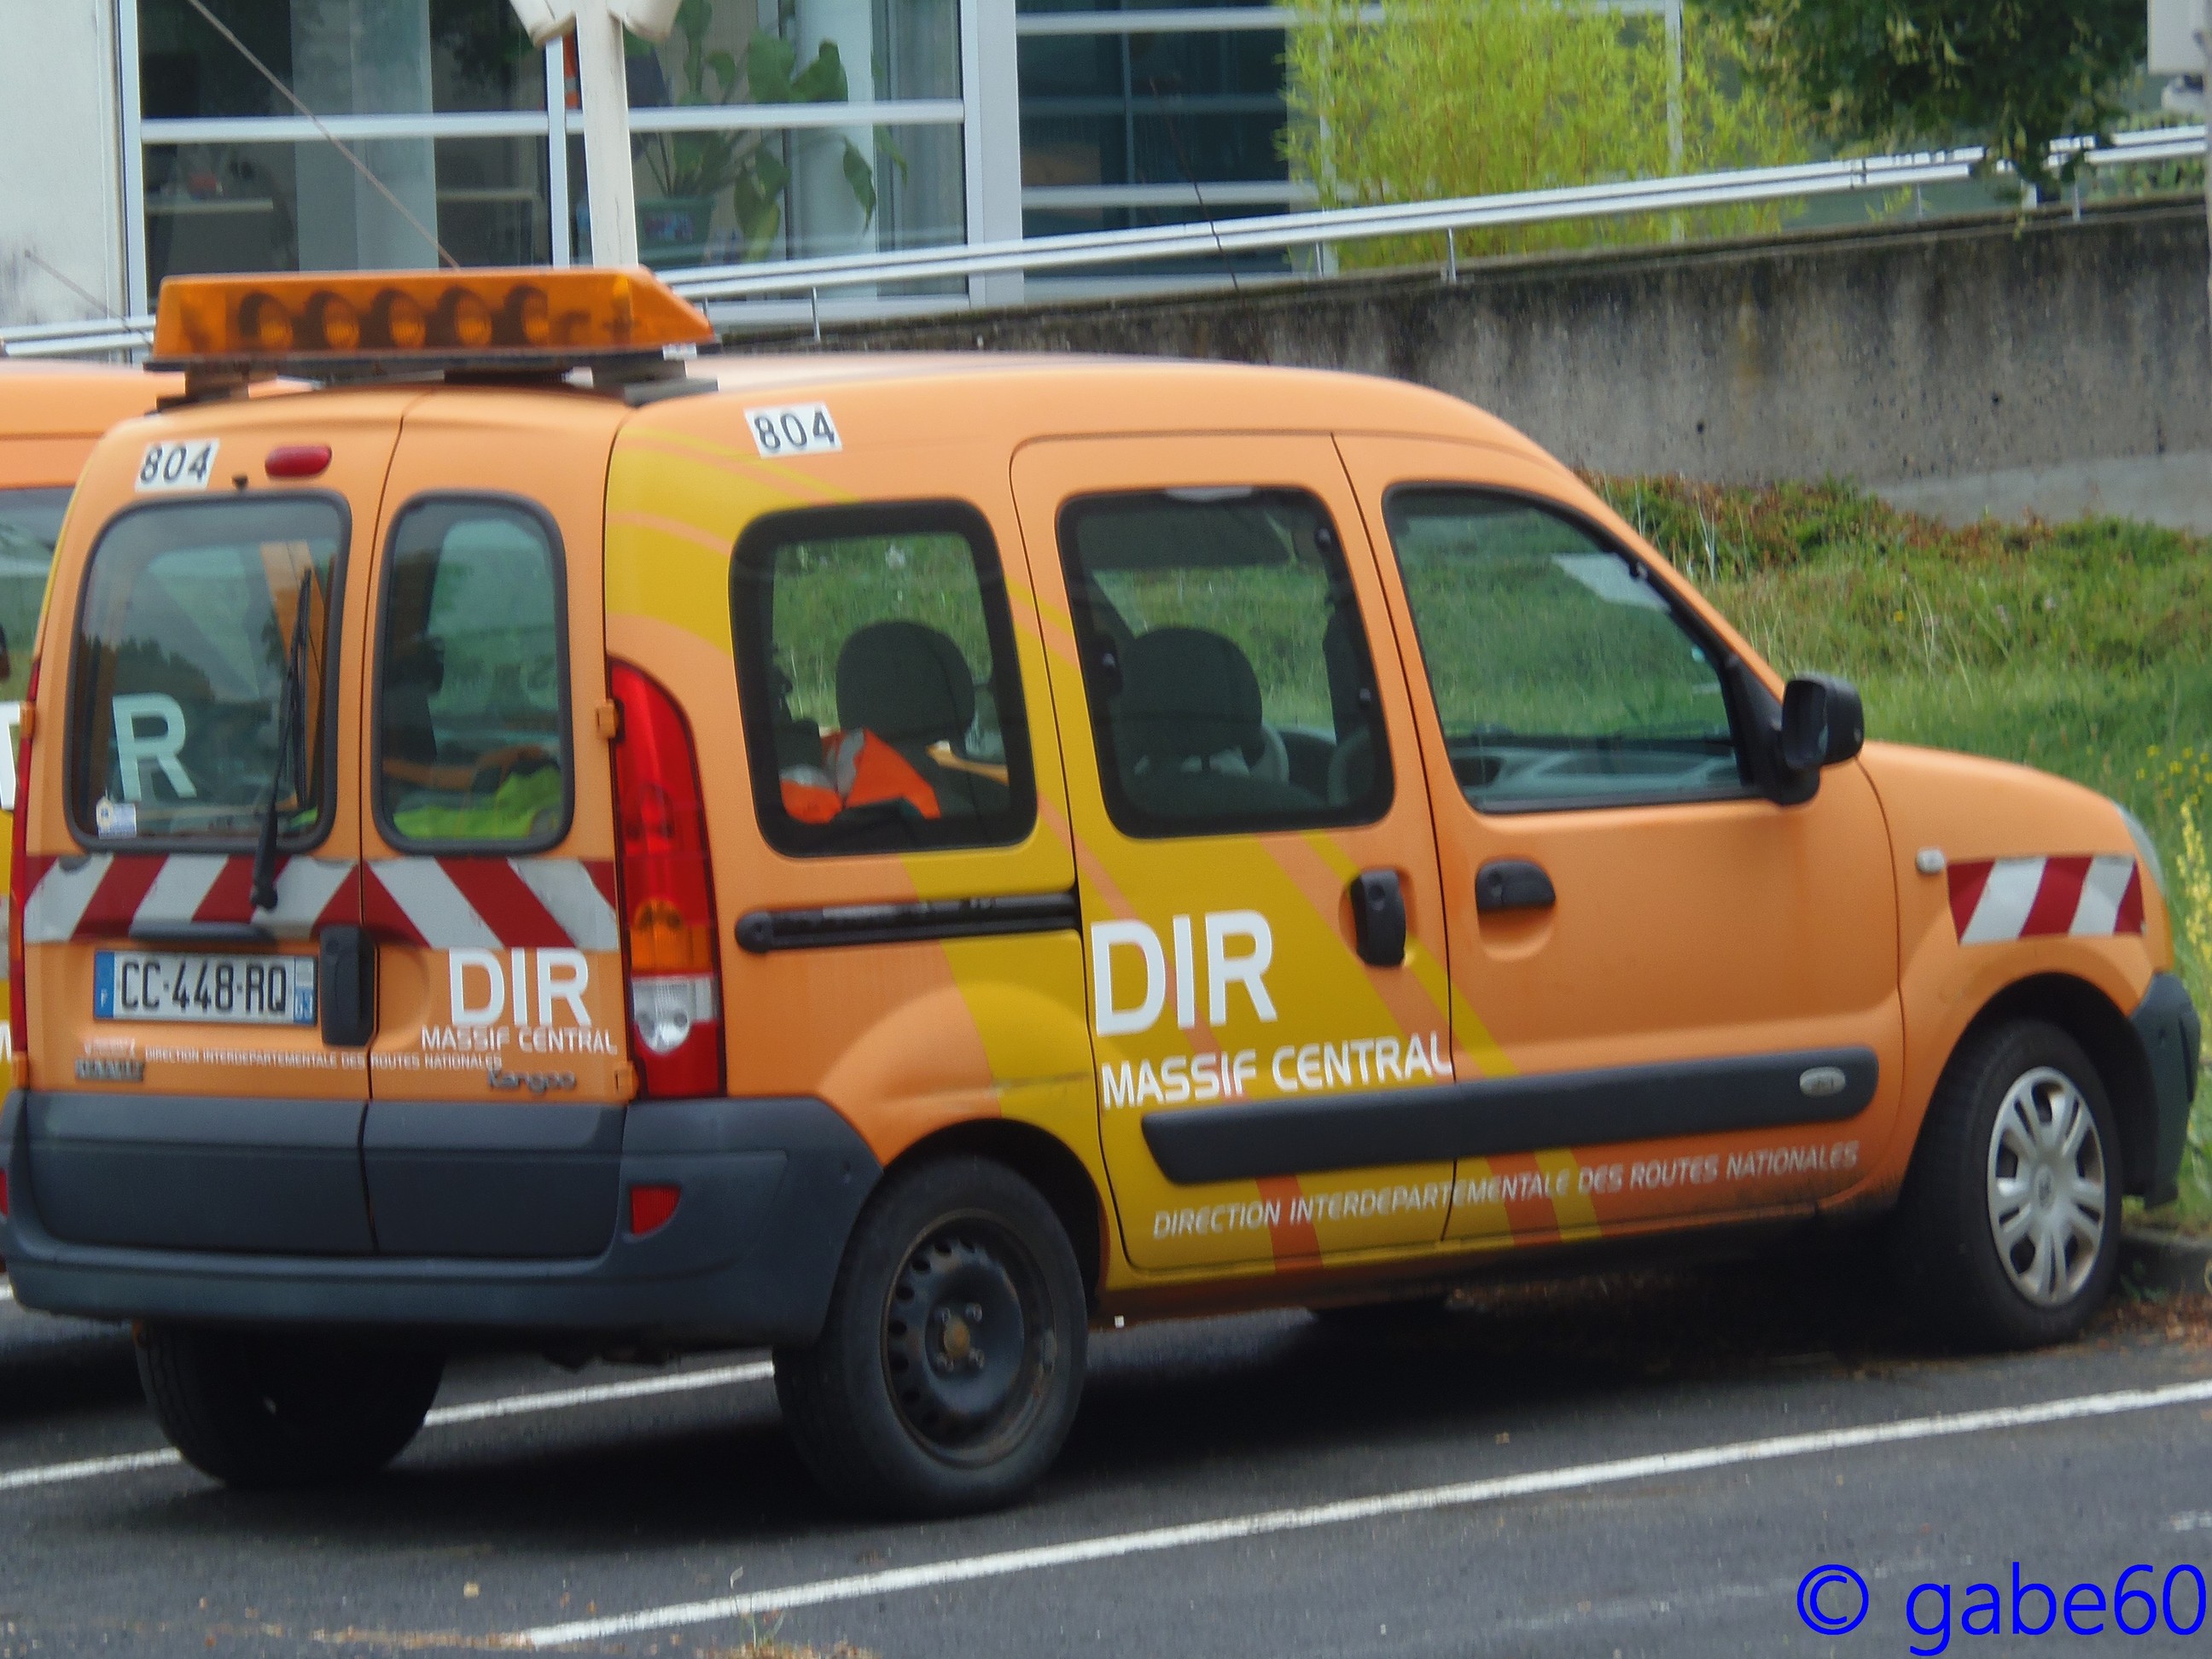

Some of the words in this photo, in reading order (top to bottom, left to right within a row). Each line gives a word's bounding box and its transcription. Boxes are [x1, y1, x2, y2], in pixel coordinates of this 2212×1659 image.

[140, 444, 212, 484] 804
[754, 410, 835, 452] 804
[449, 947, 592, 1027] DIR
[1091, 909, 1278, 1038] DIR
[422, 1025, 510, 1052] MASSIF
[518, 1026, 618, 1056] CENTRAL
[1100, 1047, 1257, 1110] MASSIF
[1272, 1030, 1453, 1092] CENTRAL
[1153, 1196, 1281, 1242] DIRECTION
[1289, 1167, 1570, 1226] INTERDEPARTEMENTALE
[1577, 1162, 1623, 1195] DES
[1629, 1154, 1720, 1189] ROUTES
[1726, 1139, 1860, 1181] NATIONALES
